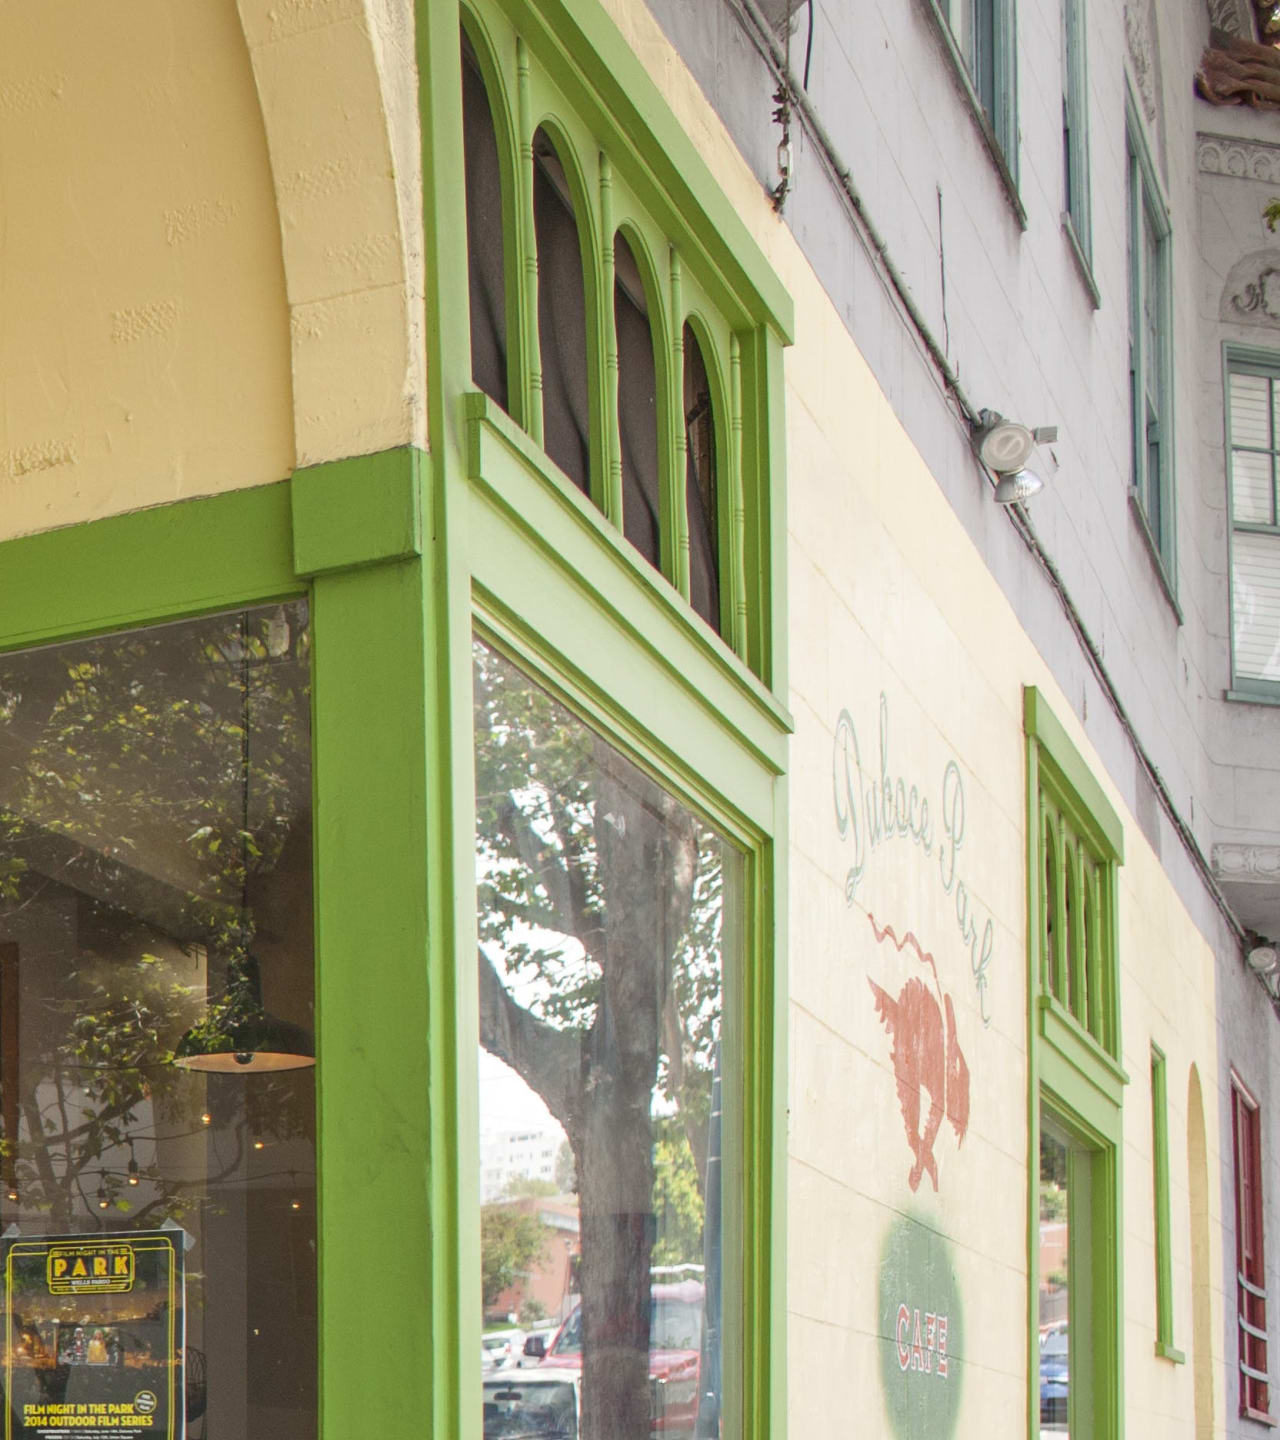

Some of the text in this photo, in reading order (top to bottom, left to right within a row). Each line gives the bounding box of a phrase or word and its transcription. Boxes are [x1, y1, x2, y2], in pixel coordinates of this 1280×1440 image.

[833, 691, 992, 1026] Duboce Park
[54, 1256, 129, 1278] PARK
[896, 1303, 948, 1378] CAFE
[23, 1403, 135, 1414] FILM NIGHT IN THE PARK
[23, 1415, 153, 1427] 2014 OUTDOOR FILM SERIES
